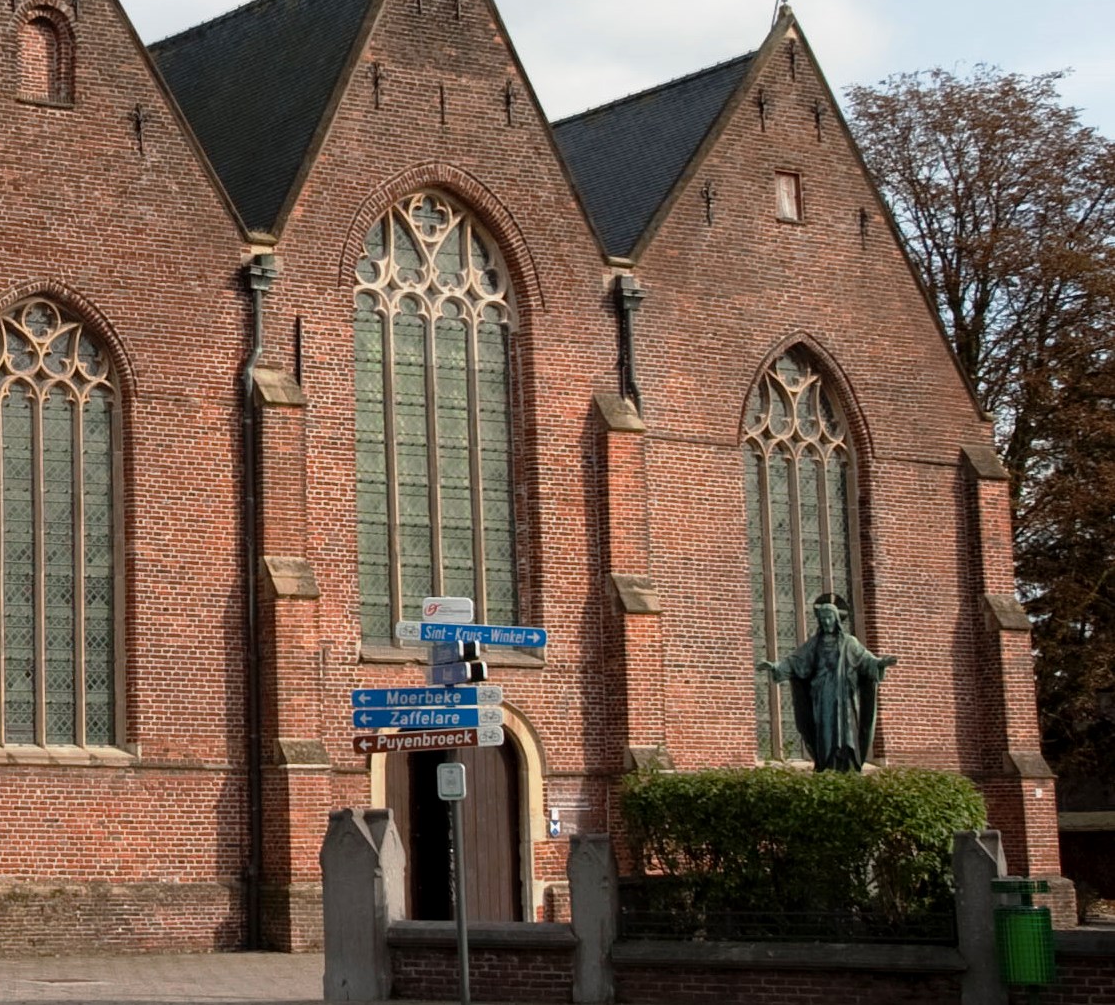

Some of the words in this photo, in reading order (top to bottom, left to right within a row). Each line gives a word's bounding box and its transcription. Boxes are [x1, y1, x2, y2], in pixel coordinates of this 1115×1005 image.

[386, 691, 461, 705] Moerbeke
[390, 711, 460, 725] Zaffelare
[377, 730, 472, 751] Puyenbroeck
